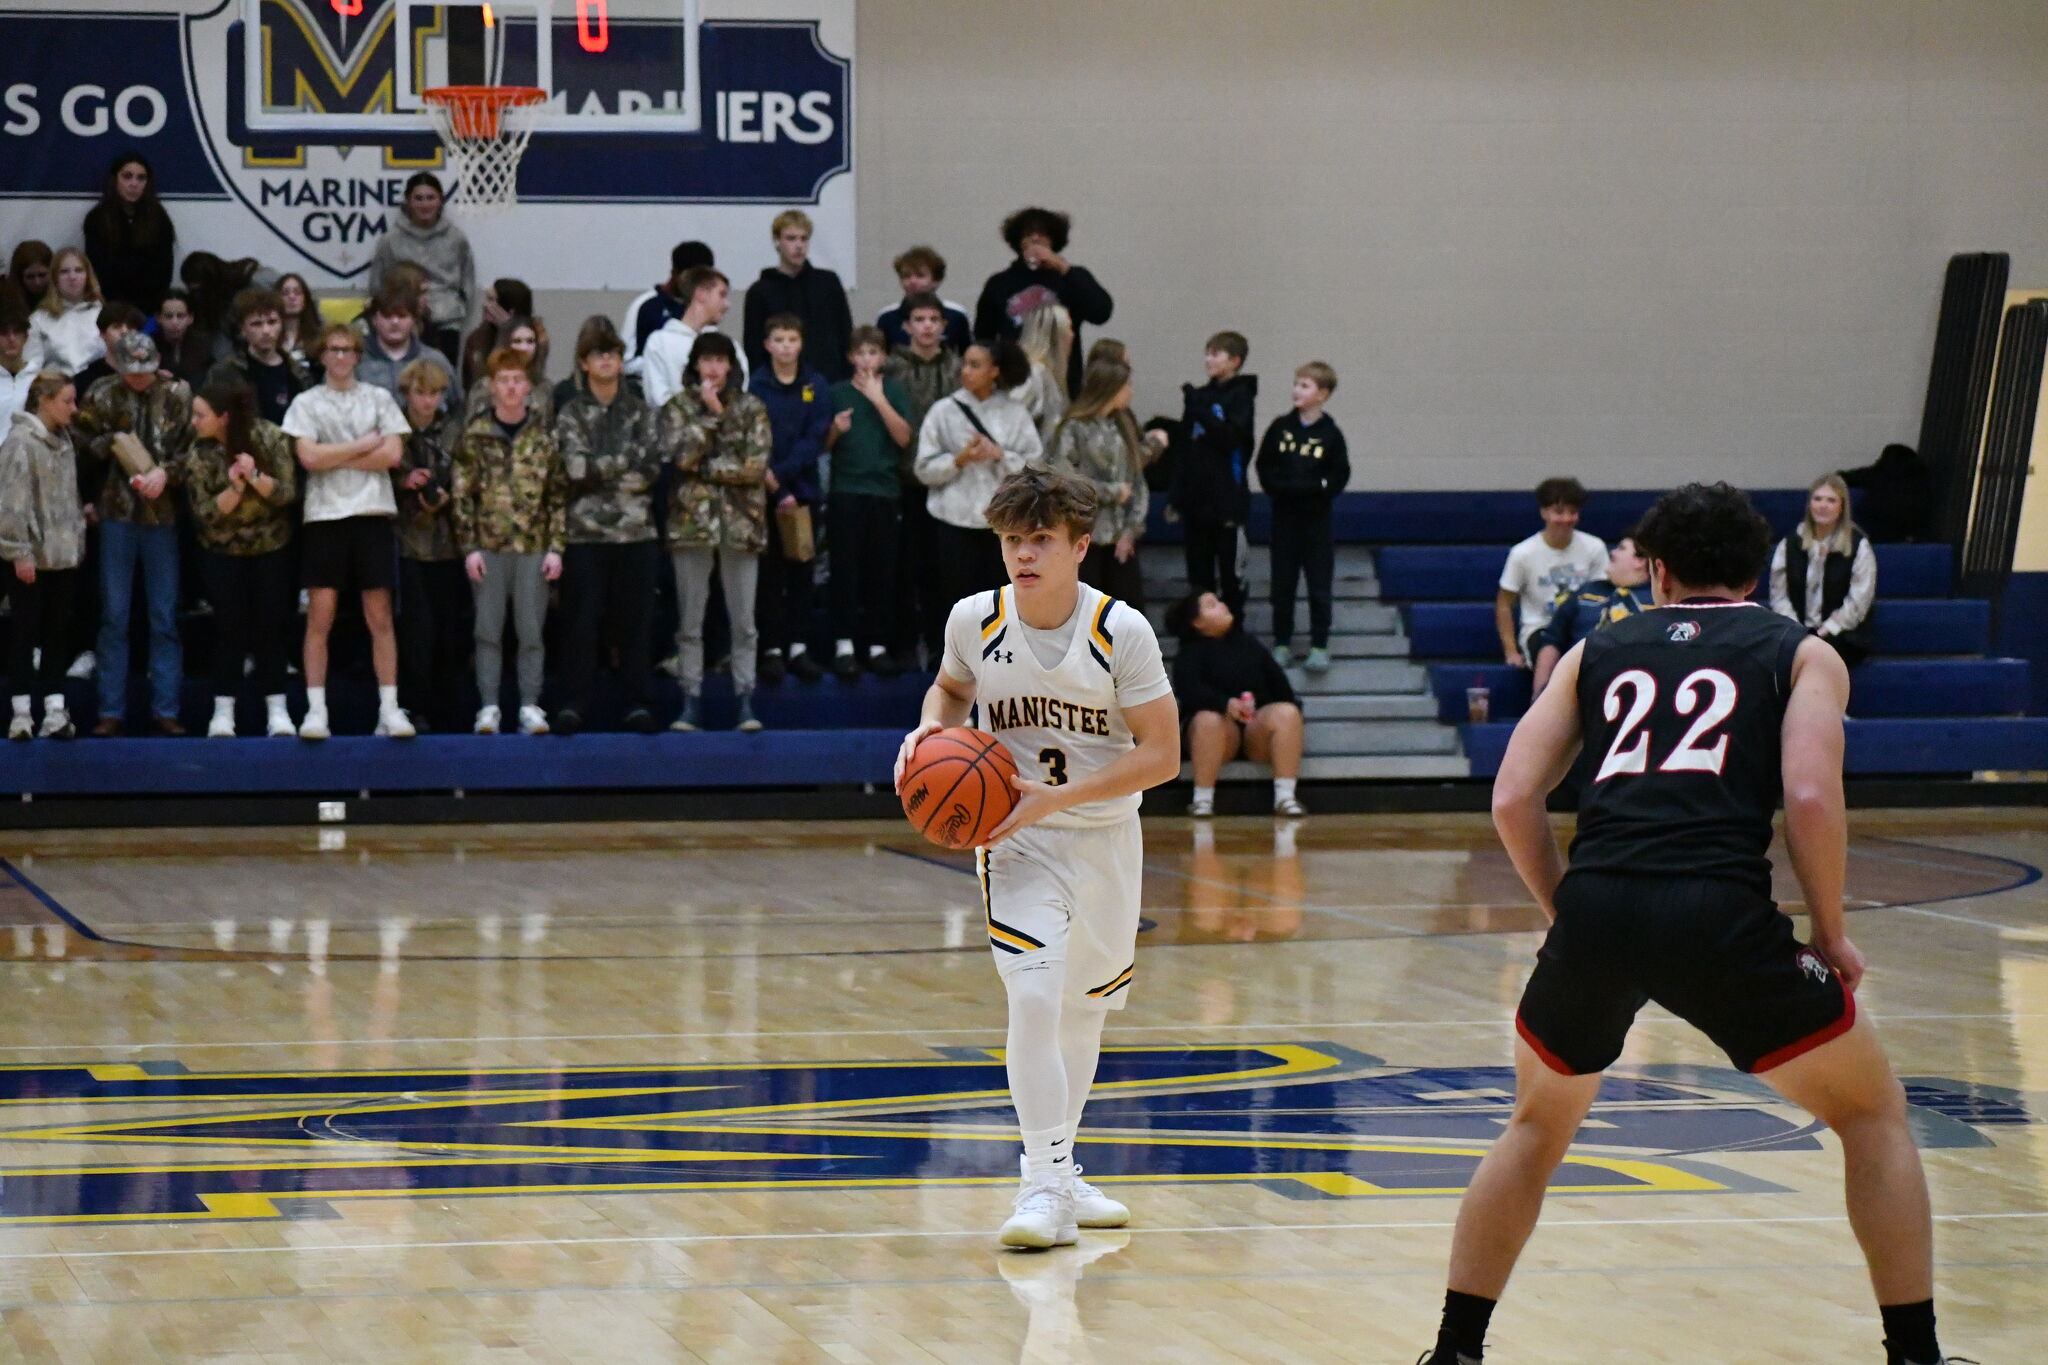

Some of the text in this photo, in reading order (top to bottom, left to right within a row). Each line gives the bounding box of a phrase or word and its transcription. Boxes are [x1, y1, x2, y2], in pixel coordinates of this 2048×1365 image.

[61, 84, 168, 138] GO
[261, 179, 403, 207] MARINE
[302, 212, 387, 243] GYM
[988, 696, 1110, 736] MANISTEE
[1594, 667, 1738, 784] 22
[1038, 748, 1069, 786] 3
